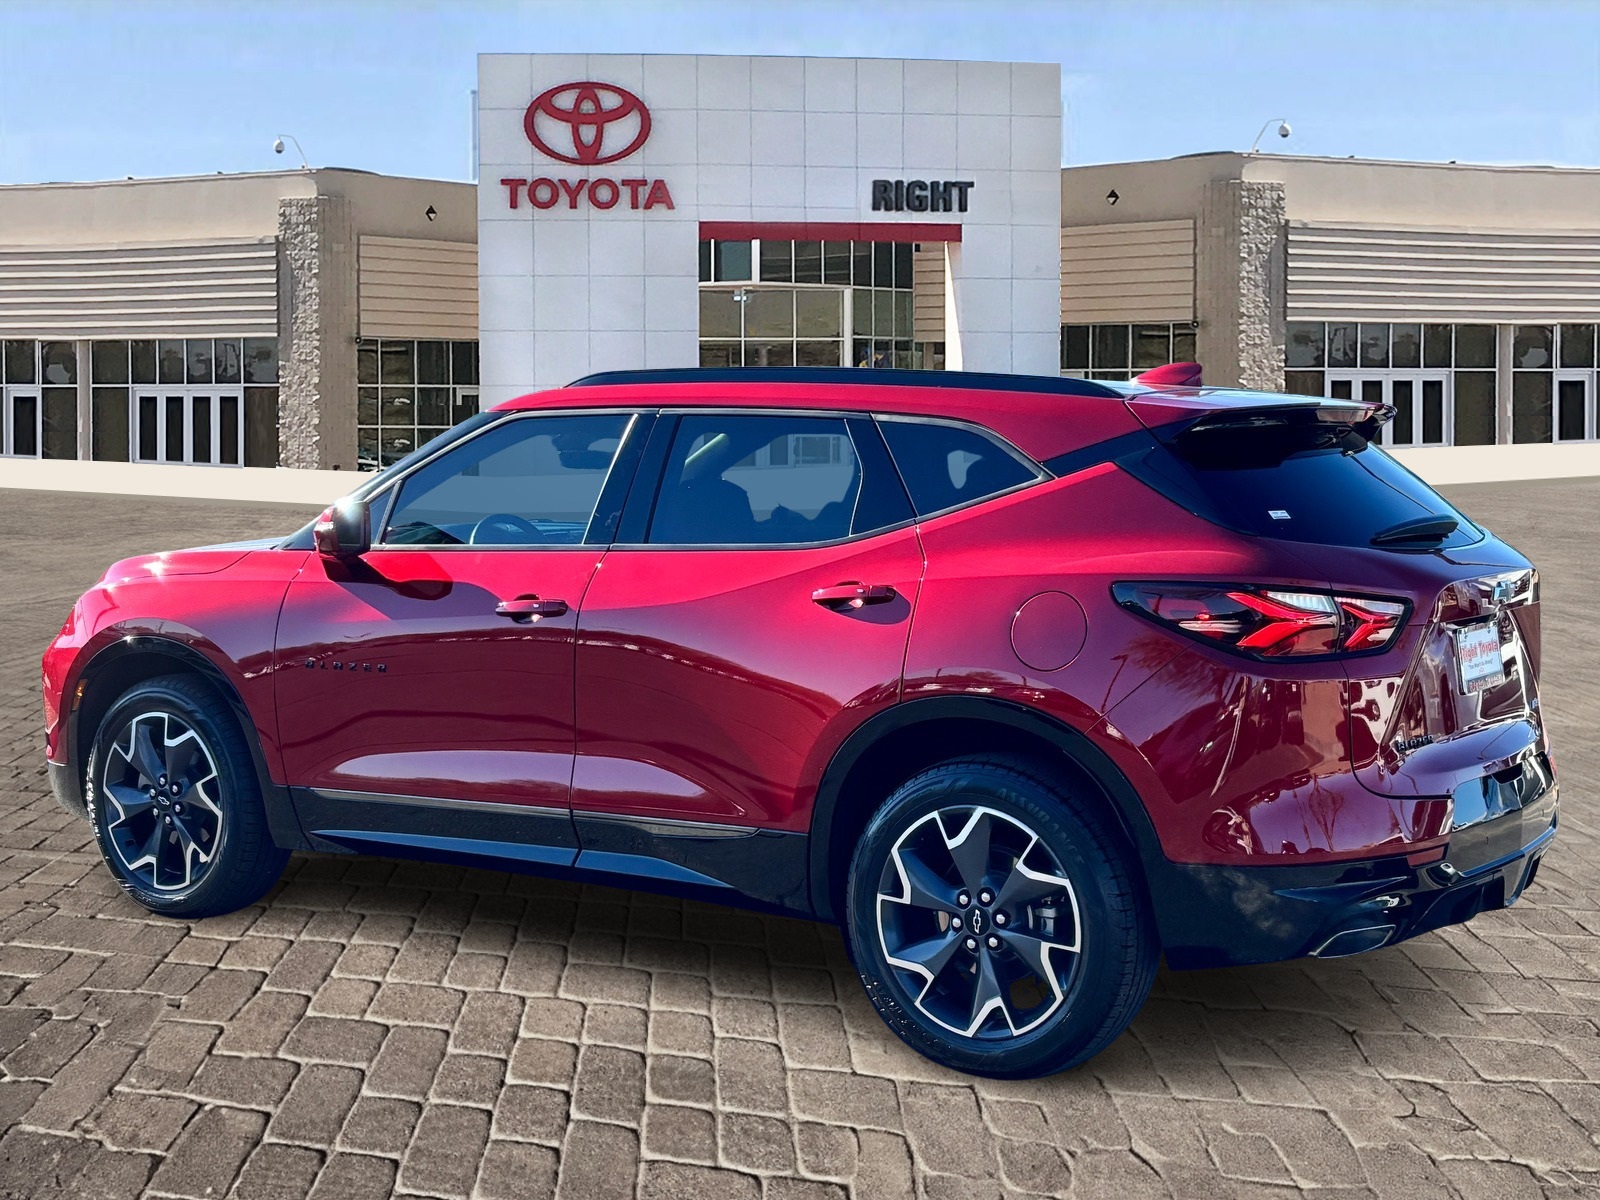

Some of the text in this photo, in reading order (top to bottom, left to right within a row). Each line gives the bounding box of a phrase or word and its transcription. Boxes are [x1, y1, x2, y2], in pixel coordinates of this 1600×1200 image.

[500, 178, 675, 209] TOYOTA
[872, 180, 975, 212] RIGHT
[1478, 639, 1499, 658] Toyota
[305, 659, 387, 673] BLAZER
